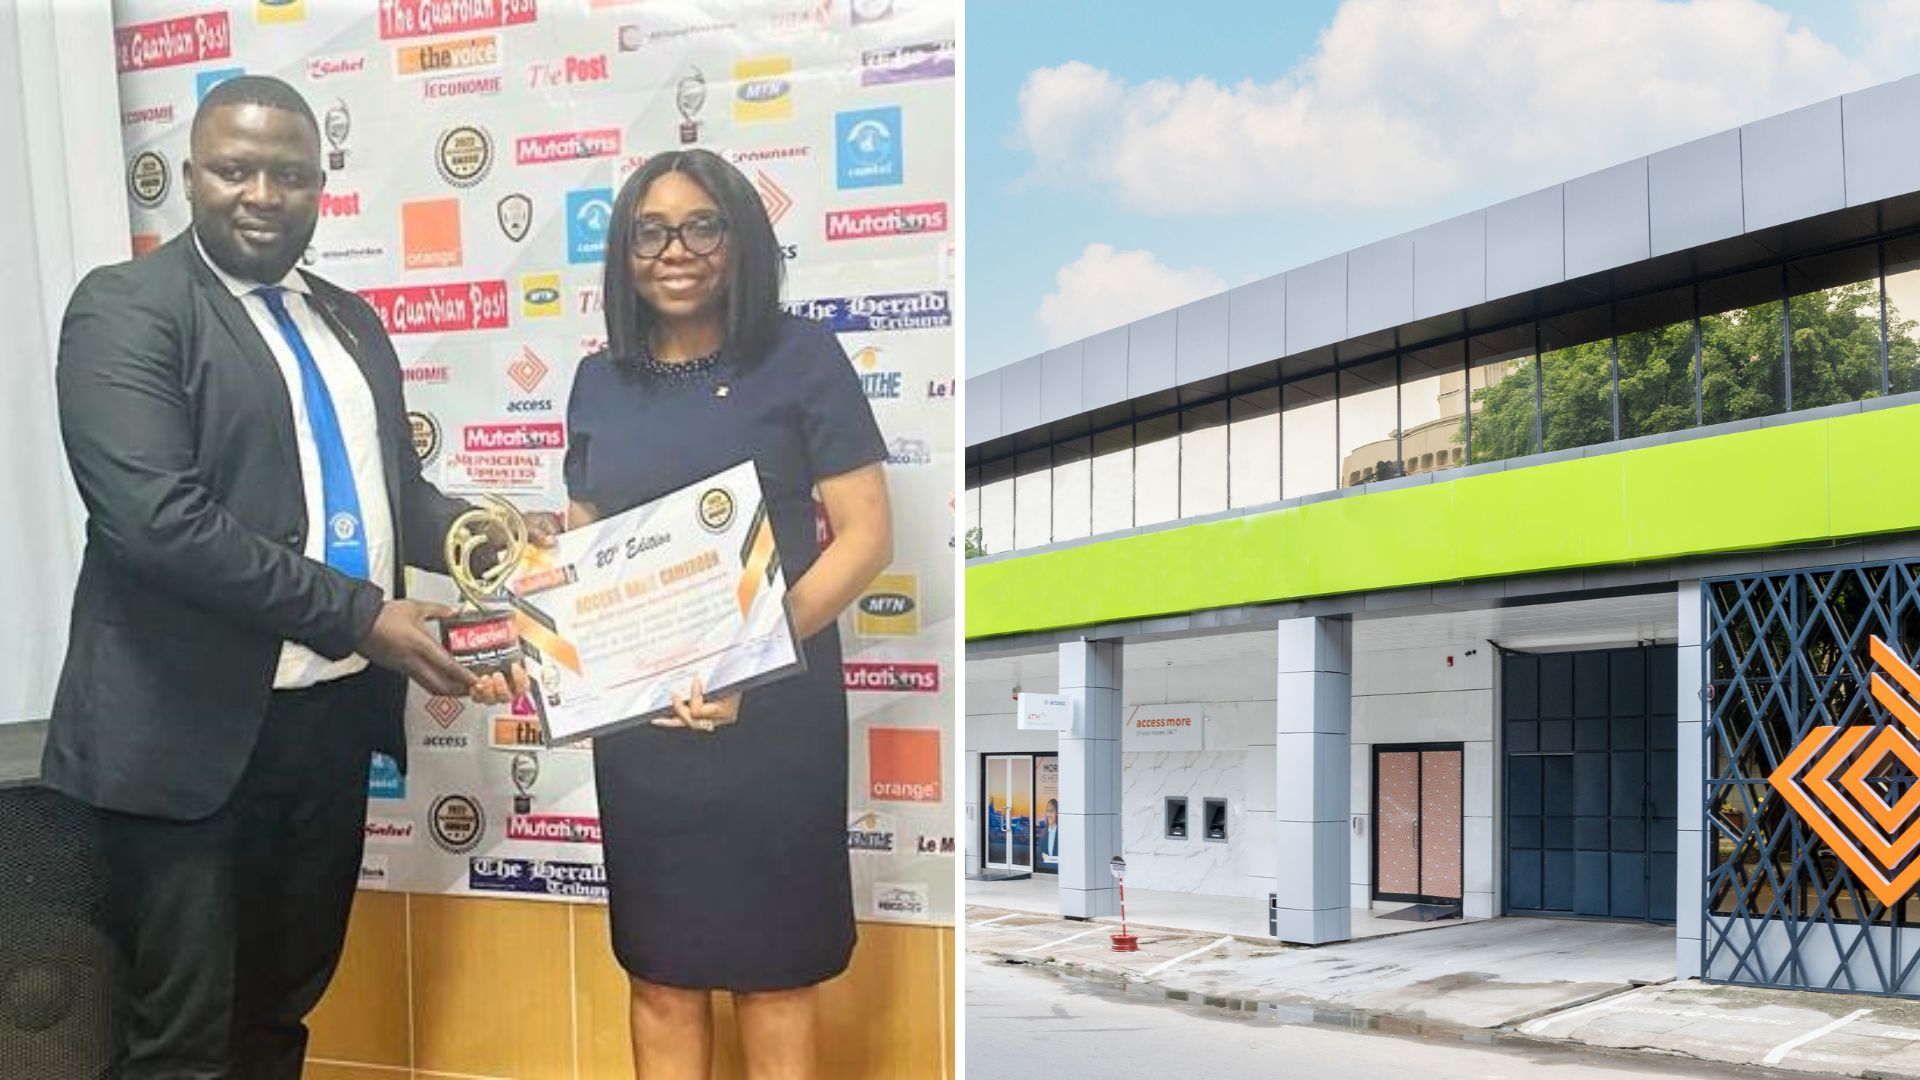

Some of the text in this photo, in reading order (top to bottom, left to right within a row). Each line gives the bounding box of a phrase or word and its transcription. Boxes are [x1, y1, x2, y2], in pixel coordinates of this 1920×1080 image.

[132, 22, 193, 67] Guardian
[195, 17, 228, 60] Post
[566, 55, 609, 84] Post
[519, 134, 618, 160] Mutations
[829, 209, 944, 235] Mutations
[394, 288, 466, 331] Guardian
[470, 284, 506, 329] Post
[506, 399, 553, 412] access
[466, 424, 562, 448] Mutations
[867, 599, 906, 613] MTN
[843, 666, 936, 688] utations
[423, 735, 468, 748] access
[873, 781, 935, 800] orange
[918, 835, 937, 853] Le
[474, 858, 523, 879] The
